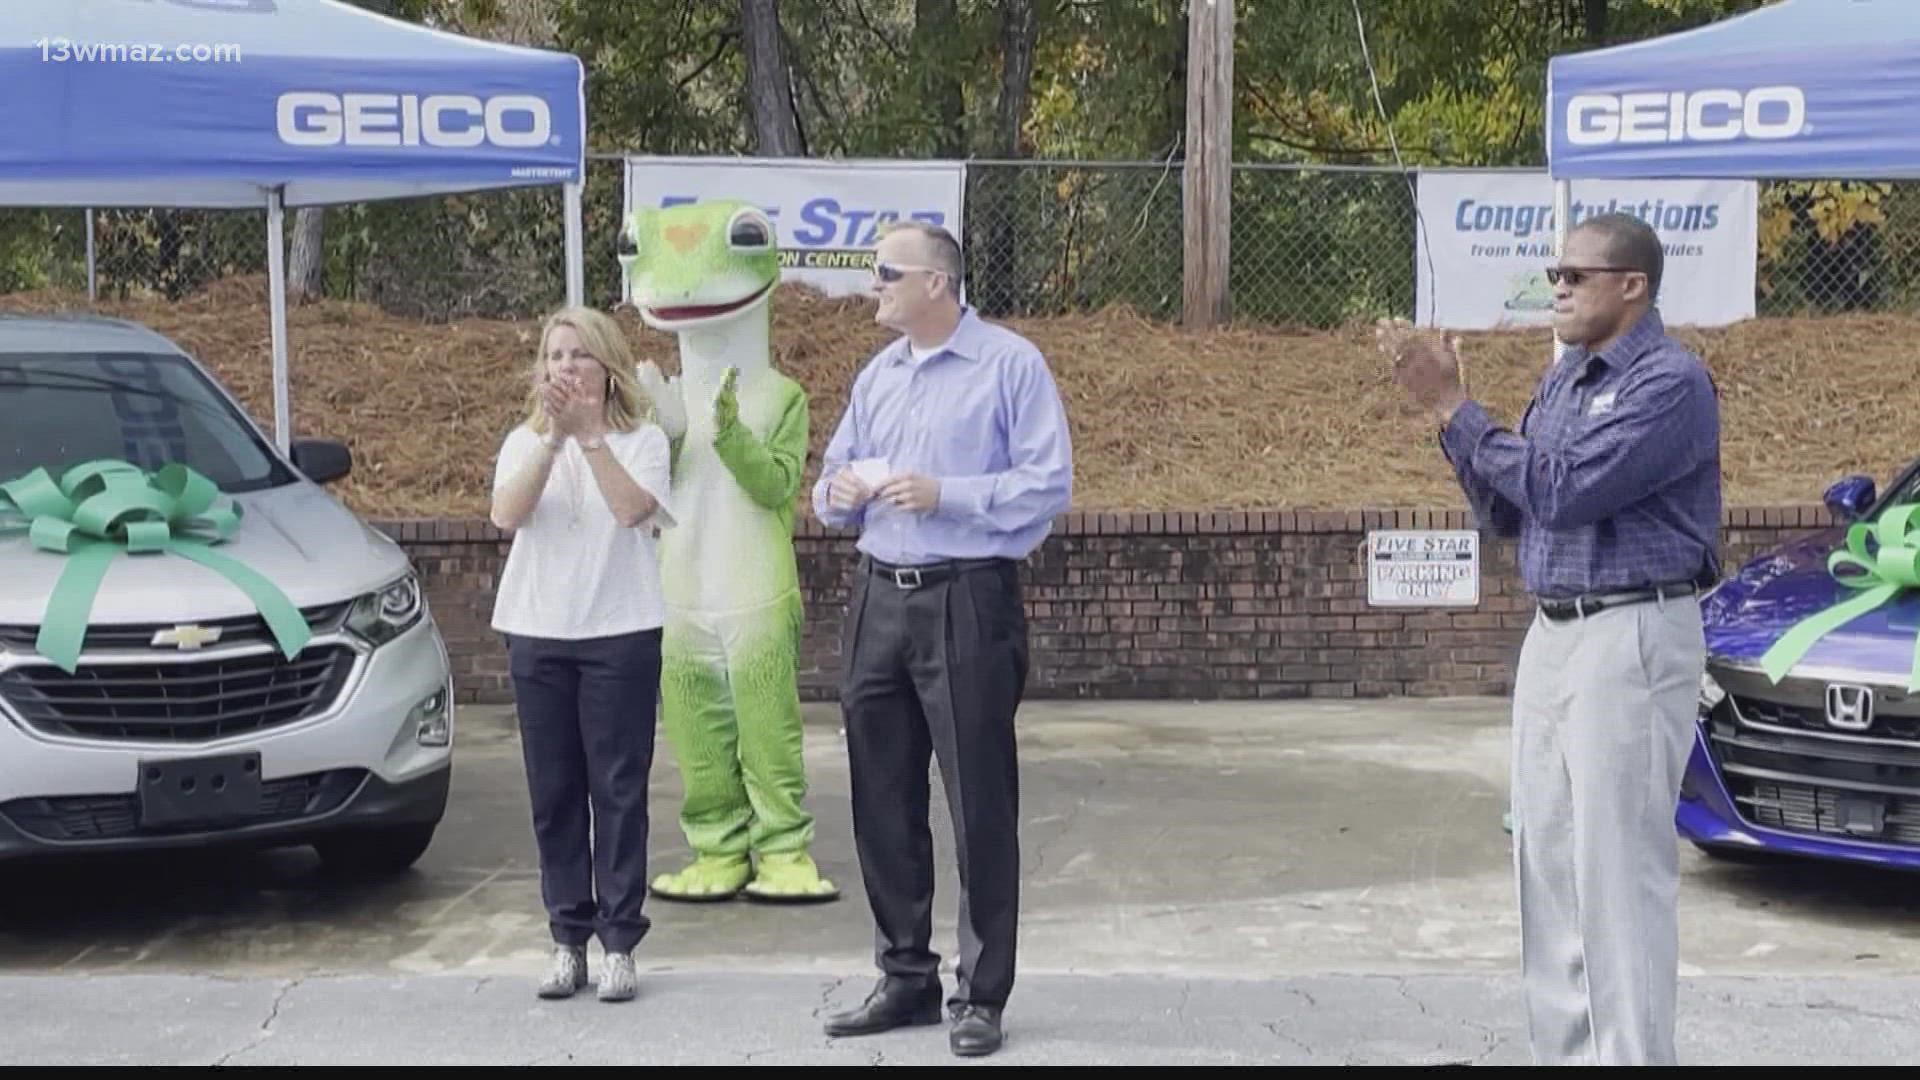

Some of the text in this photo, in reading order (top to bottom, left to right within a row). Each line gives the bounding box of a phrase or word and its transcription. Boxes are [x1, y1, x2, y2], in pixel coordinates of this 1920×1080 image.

[276, 92, 552, 147] GEICO
[1566, 86, 1805, 145] GEICO
[1471, 243, 1510, 257] from
[1515, 242, 1558, 257] NAB
[1376, 535, 1471, 552] FIVE STAR
[1376, 563, 1471, 582] PARKING
[1395, 580, 1455, 598] ONLY
